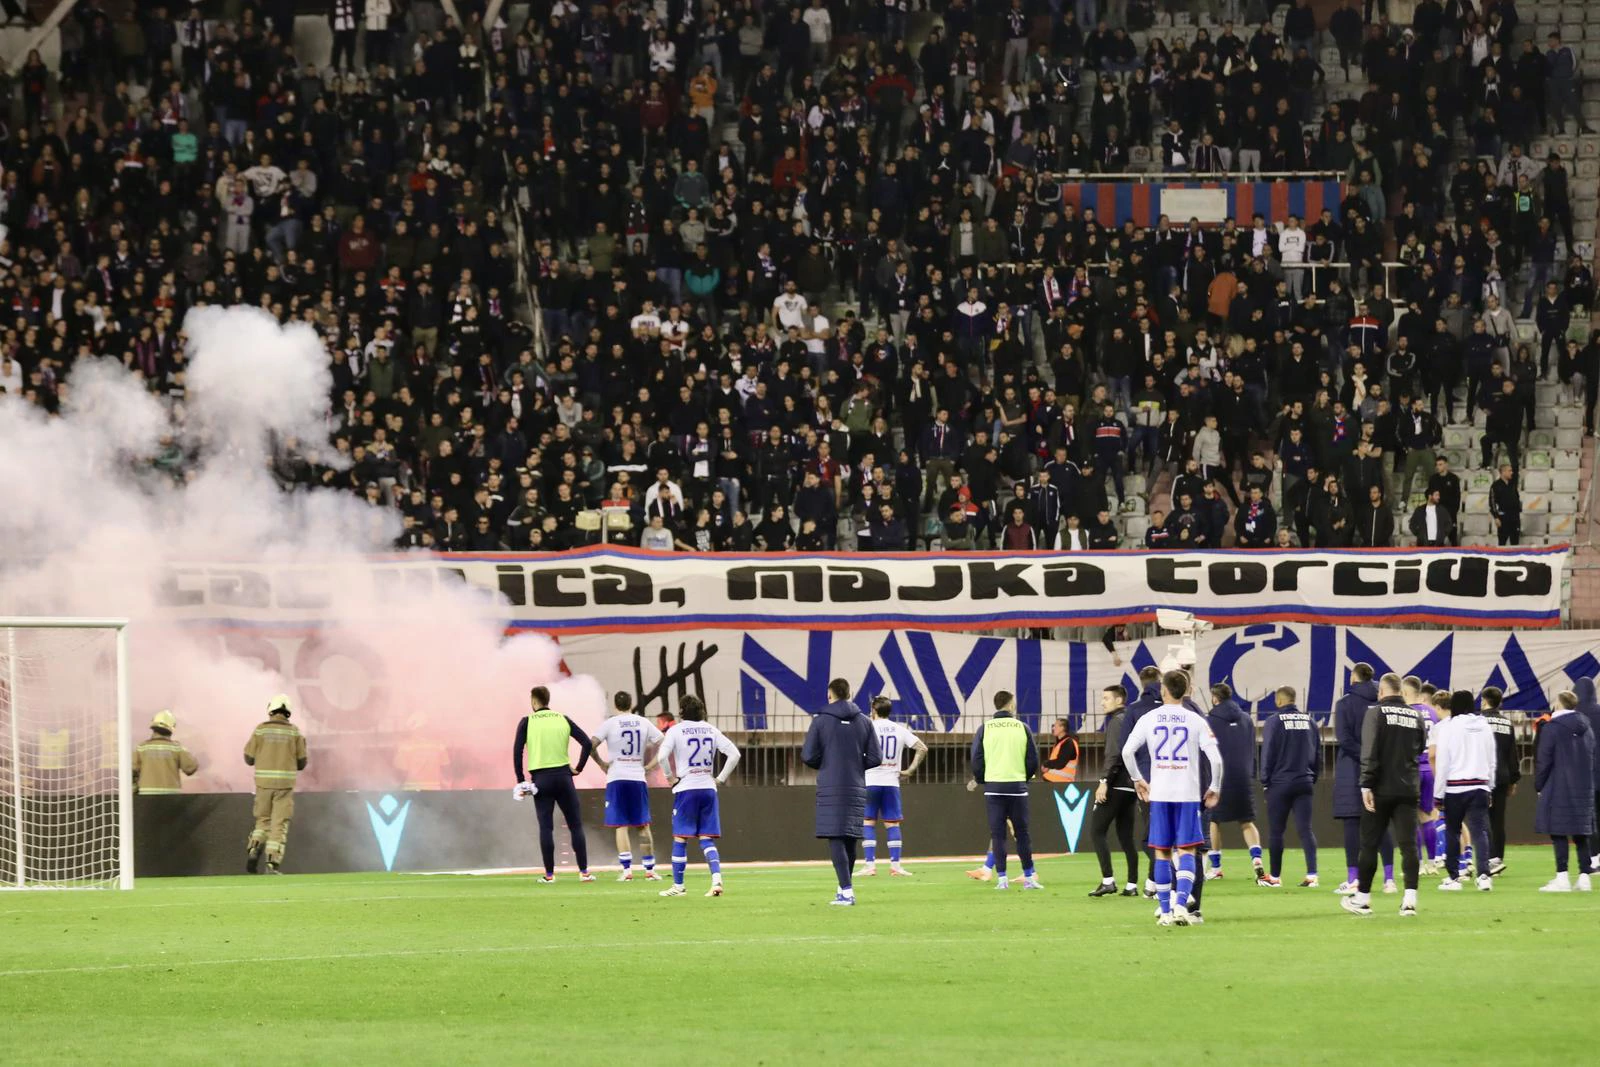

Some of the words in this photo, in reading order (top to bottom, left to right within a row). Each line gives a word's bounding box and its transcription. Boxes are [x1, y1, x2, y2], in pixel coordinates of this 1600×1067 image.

[727, 561, 1106, 602] majka
[1146, 557, 1552, 597] torcida
[1157, 714, 1185, 722] DAJAKU
[1380, 706, 1419, 718] macron
[986, 722, 1022, 730] macron
[621, 730, 641, 755] 31
[687, 737, 713, 766] 23
[880, 735, 897, 760] 10
[1153, 725, 1188, 761] 22
